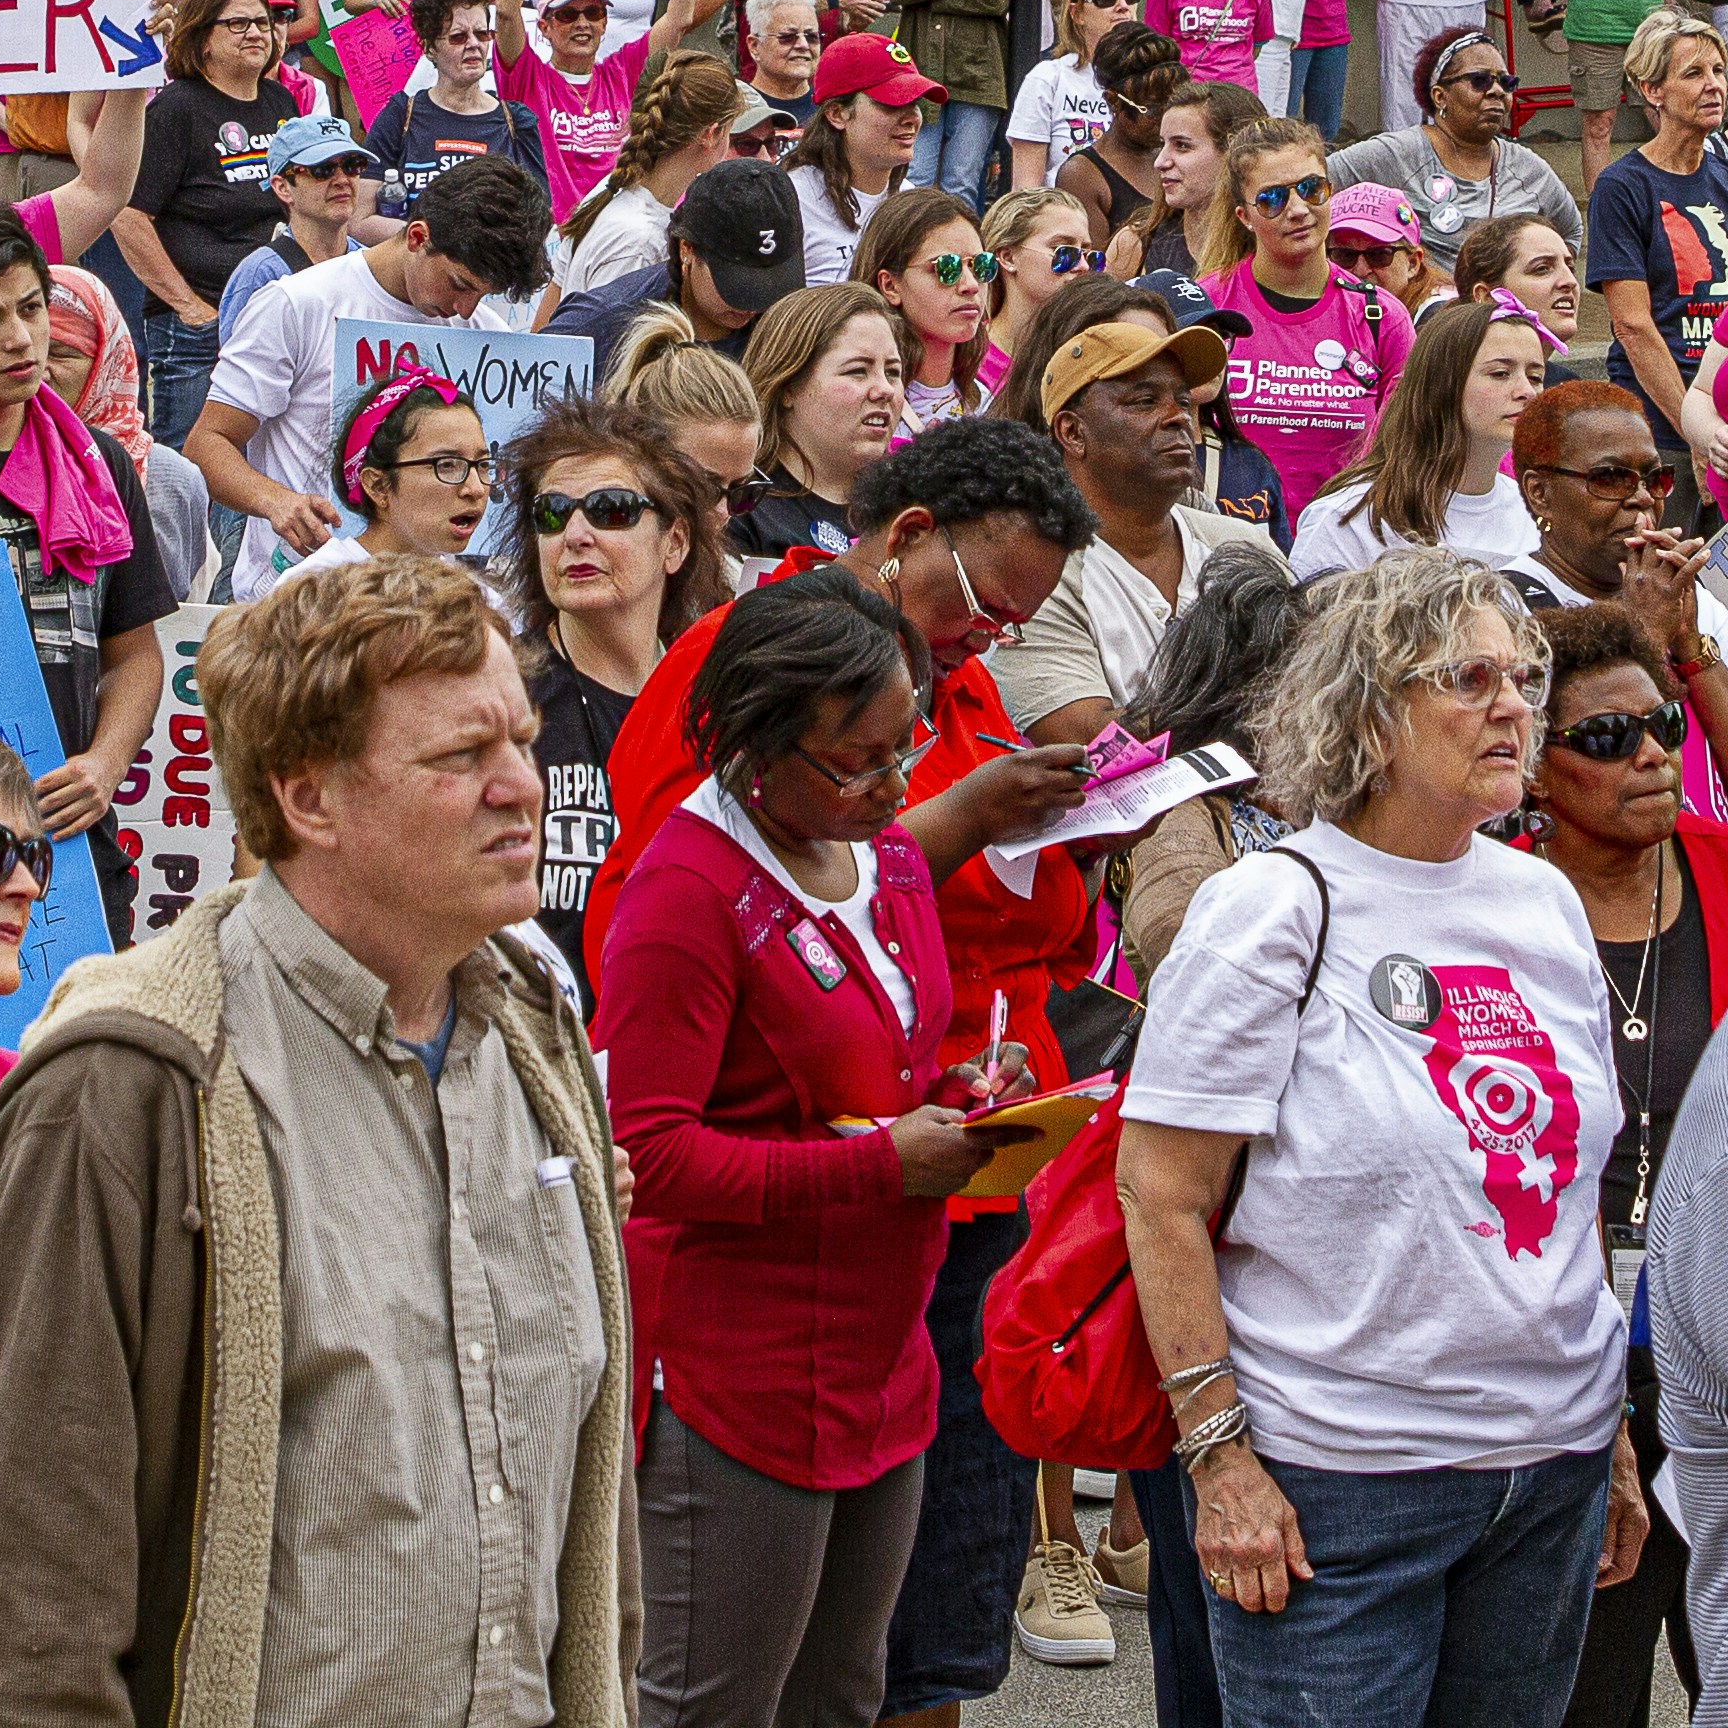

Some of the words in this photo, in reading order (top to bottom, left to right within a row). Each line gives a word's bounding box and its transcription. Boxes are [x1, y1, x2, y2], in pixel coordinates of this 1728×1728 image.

[1063, 94, 1107, 116] Neve
[224, 164, 270, 184] NEXT
[1331, 203, 1381, 219] EDUCATE
[758, 229, 775, 255] 3
[436, 342, 589, 411] WOMEN
[1278, 398, 1293, 407] No
[1294, 399, 1325, 409] matter
[1251, 415, 1308, 427] Parenthood
[1311, 417, 1344, 429] Action
[1345, 420, 1366, 430] Fund
[162, 713, 214, 830] DUE
[540, 864, 593, 912] NOT
[1445, 984, 1521, 1008] ILLINOIS
[1393, 1004, 1427, 1022] RESIST
[1450, 1004, 1528, 1024] WOMEN
[1457, 1021, 1513, 1040] MARCH
[1516, 1020, 1540, 1034] ON
[1461, 1034, 1545, 1053] SPRINGFIELD
[1470, 1117, 1539, 1154] 4-25-2017
